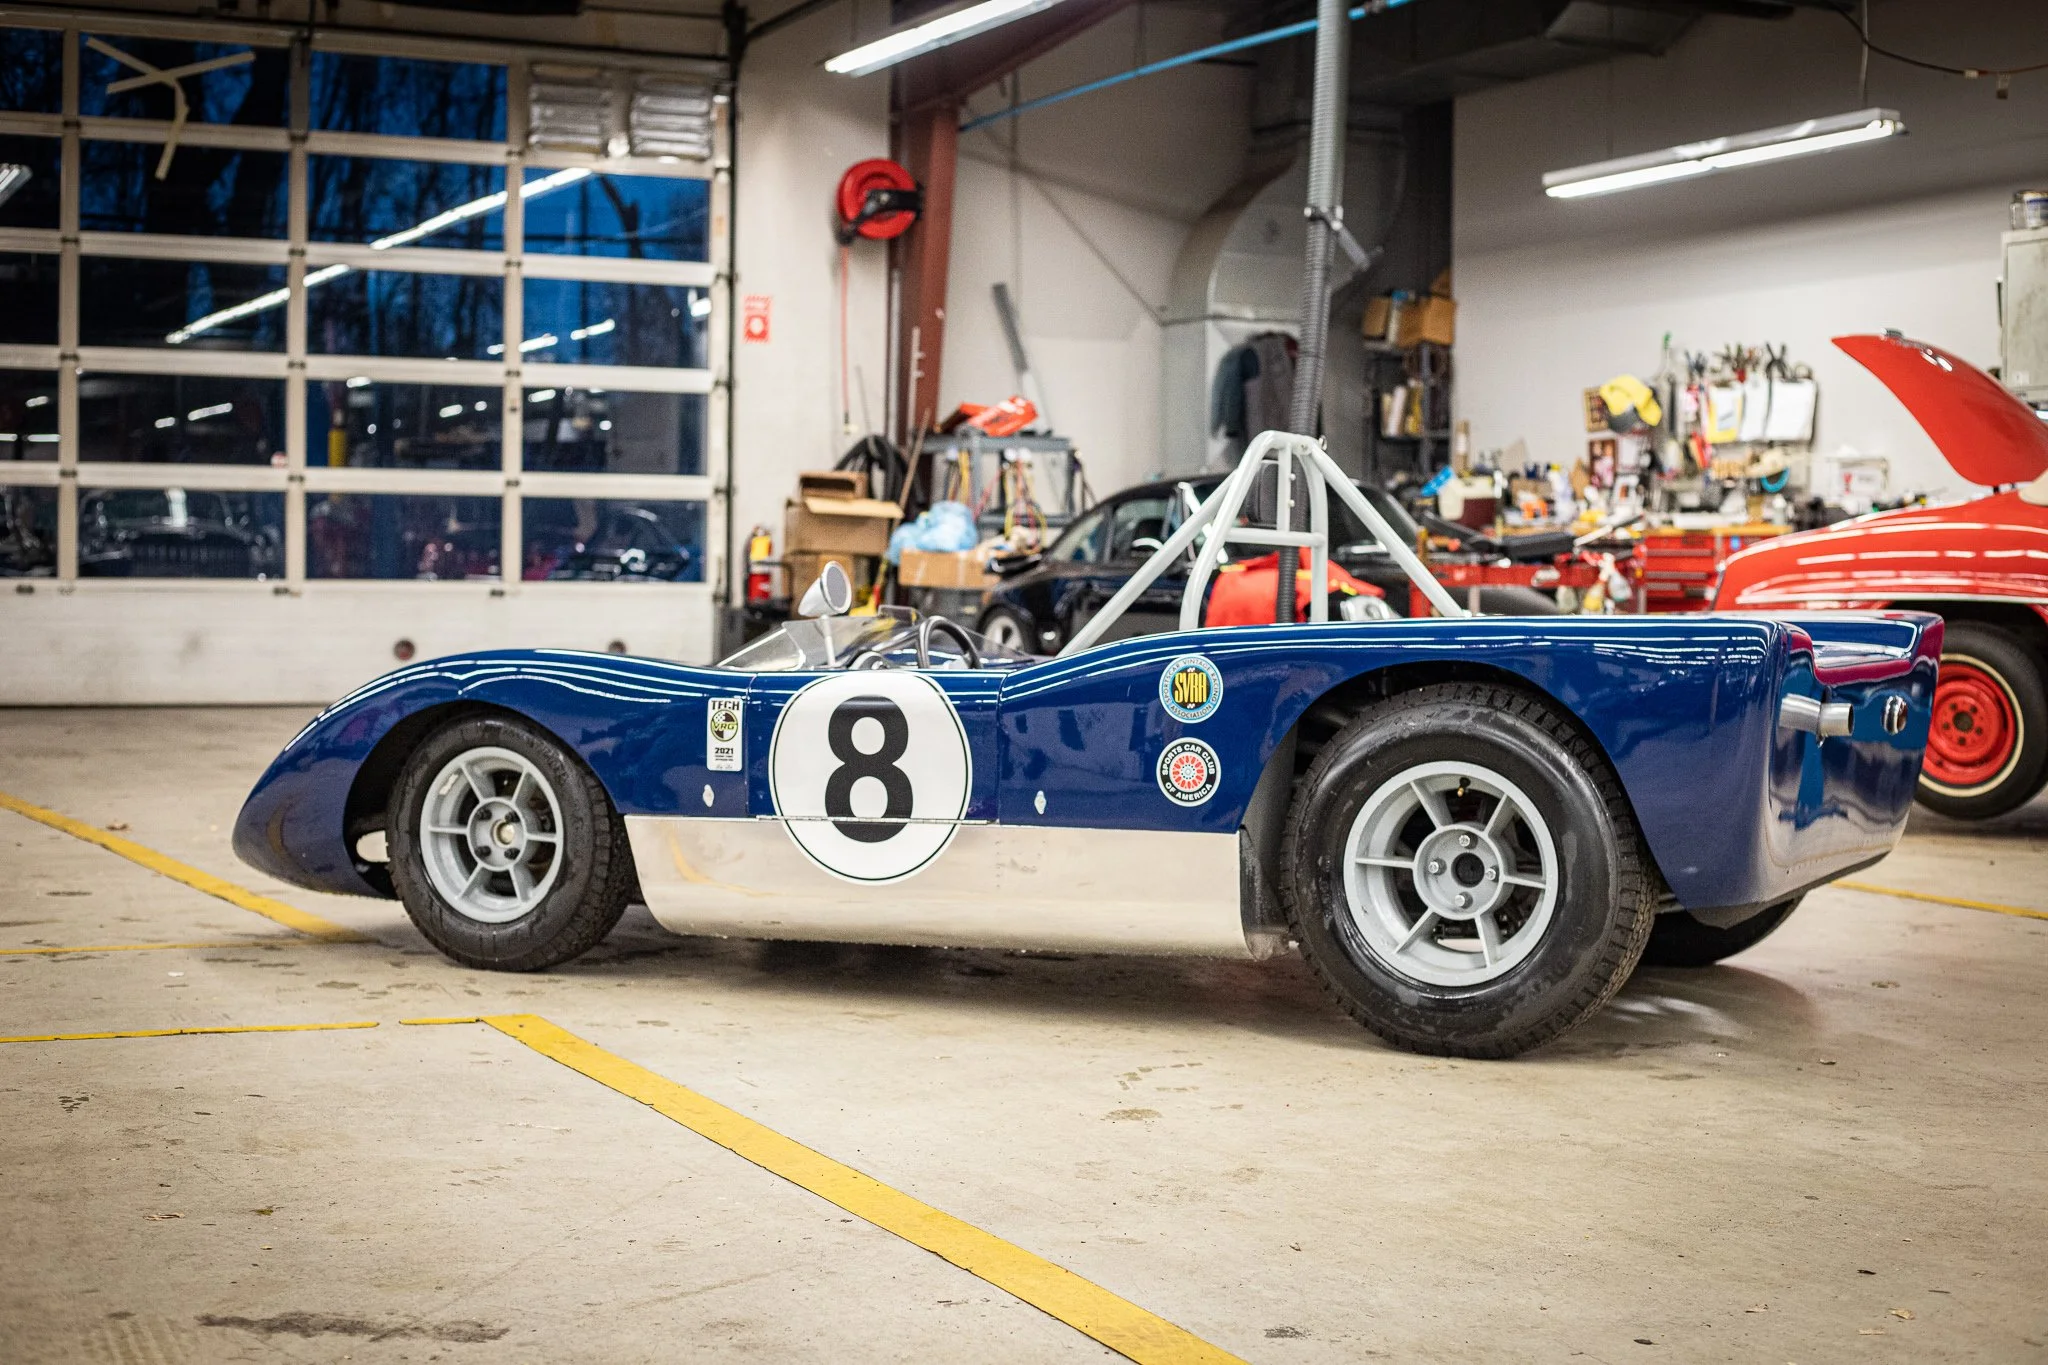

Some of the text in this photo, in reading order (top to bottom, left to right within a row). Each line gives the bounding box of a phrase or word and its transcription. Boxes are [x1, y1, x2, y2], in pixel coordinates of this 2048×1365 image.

[1174, 672, 1207, 703] SVRA
[1182, 659, 1211, 671] VINTAGE
[1210, 673, 1219, 702] RACING
[711, 700, 740, 711] TECH
[1170, 705, 1212, 718] ASSOCIATION
[825, 694, 913, 843] 8
[1162, 744, 1215, 775] SPORTS CAR CLUB
[1165, 782, 1212, 800] OF AMERICA
